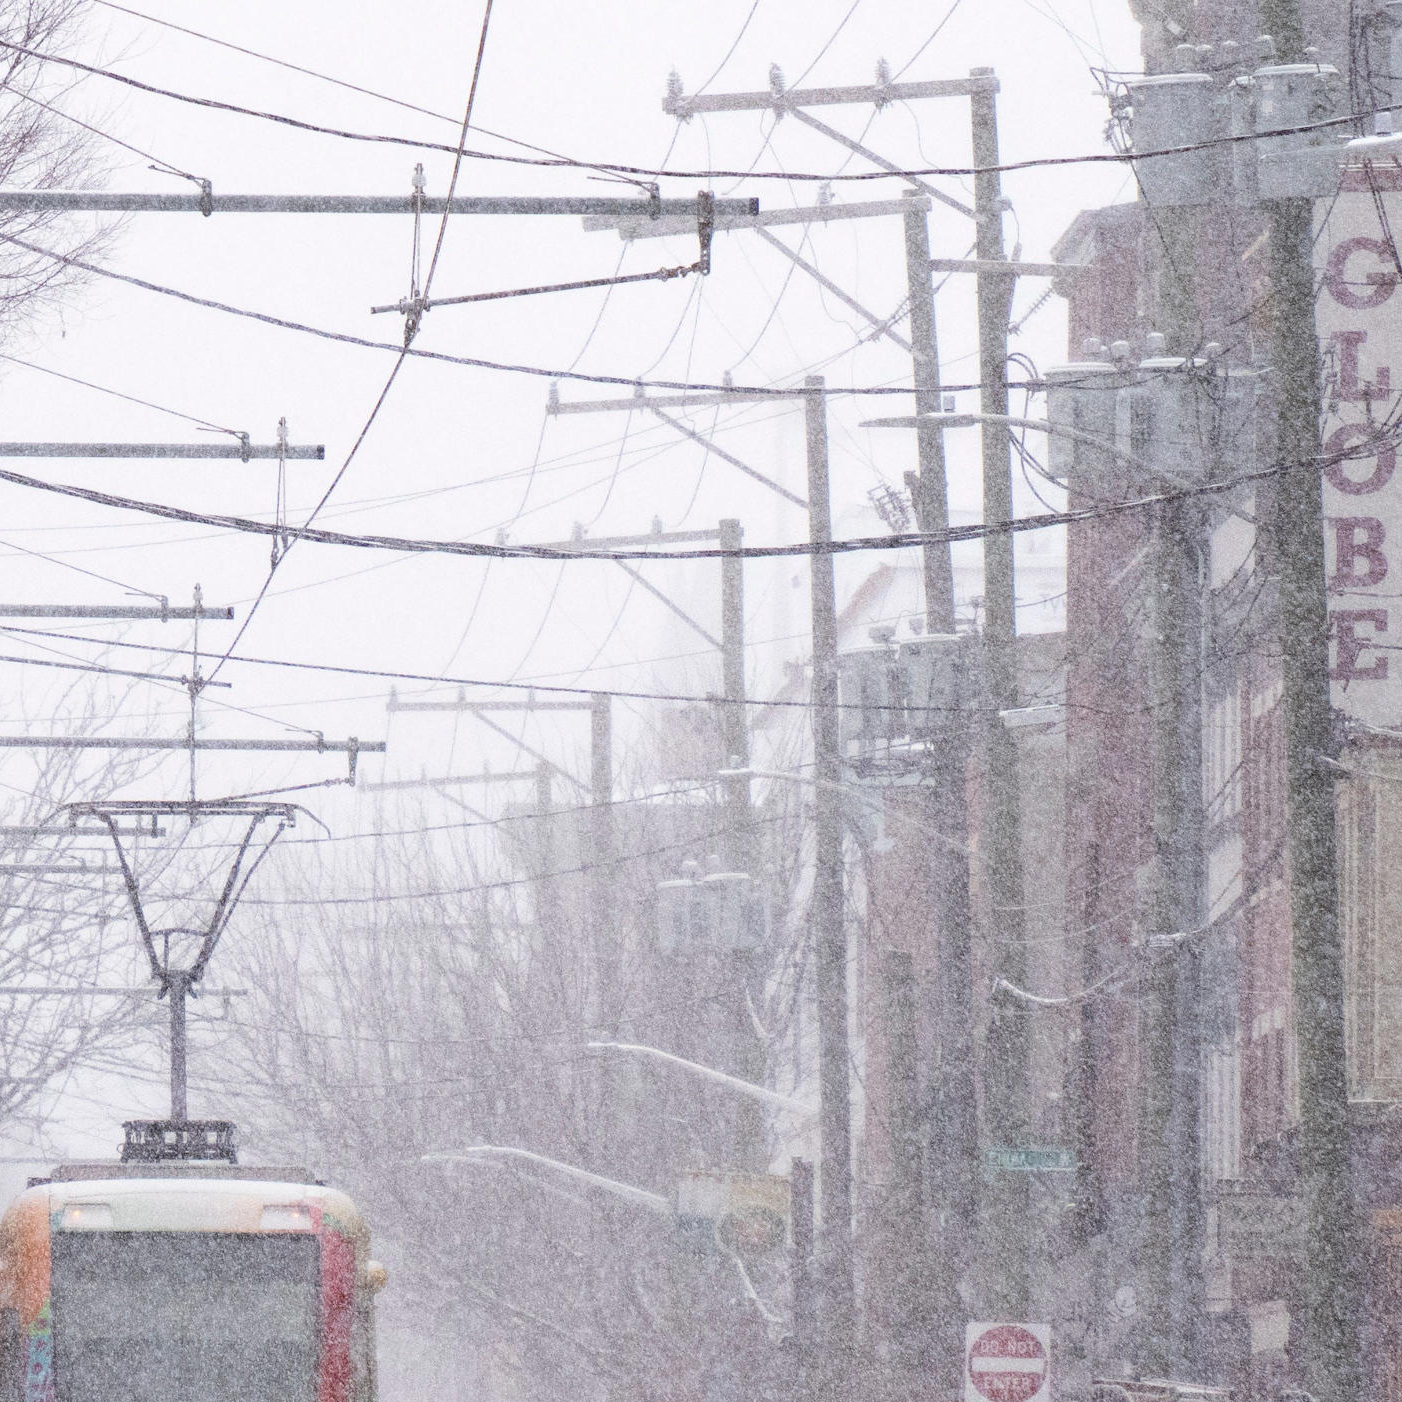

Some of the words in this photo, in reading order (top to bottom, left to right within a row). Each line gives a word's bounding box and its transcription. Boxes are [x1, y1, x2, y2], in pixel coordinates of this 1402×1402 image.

[1323, 236, 1398, 682] GLOBE
[980, 1340, 999, 1353] DO
[1007, 1339, 1035, 1354] NOT
[984, 1376, 1031, 1391] ENTER
